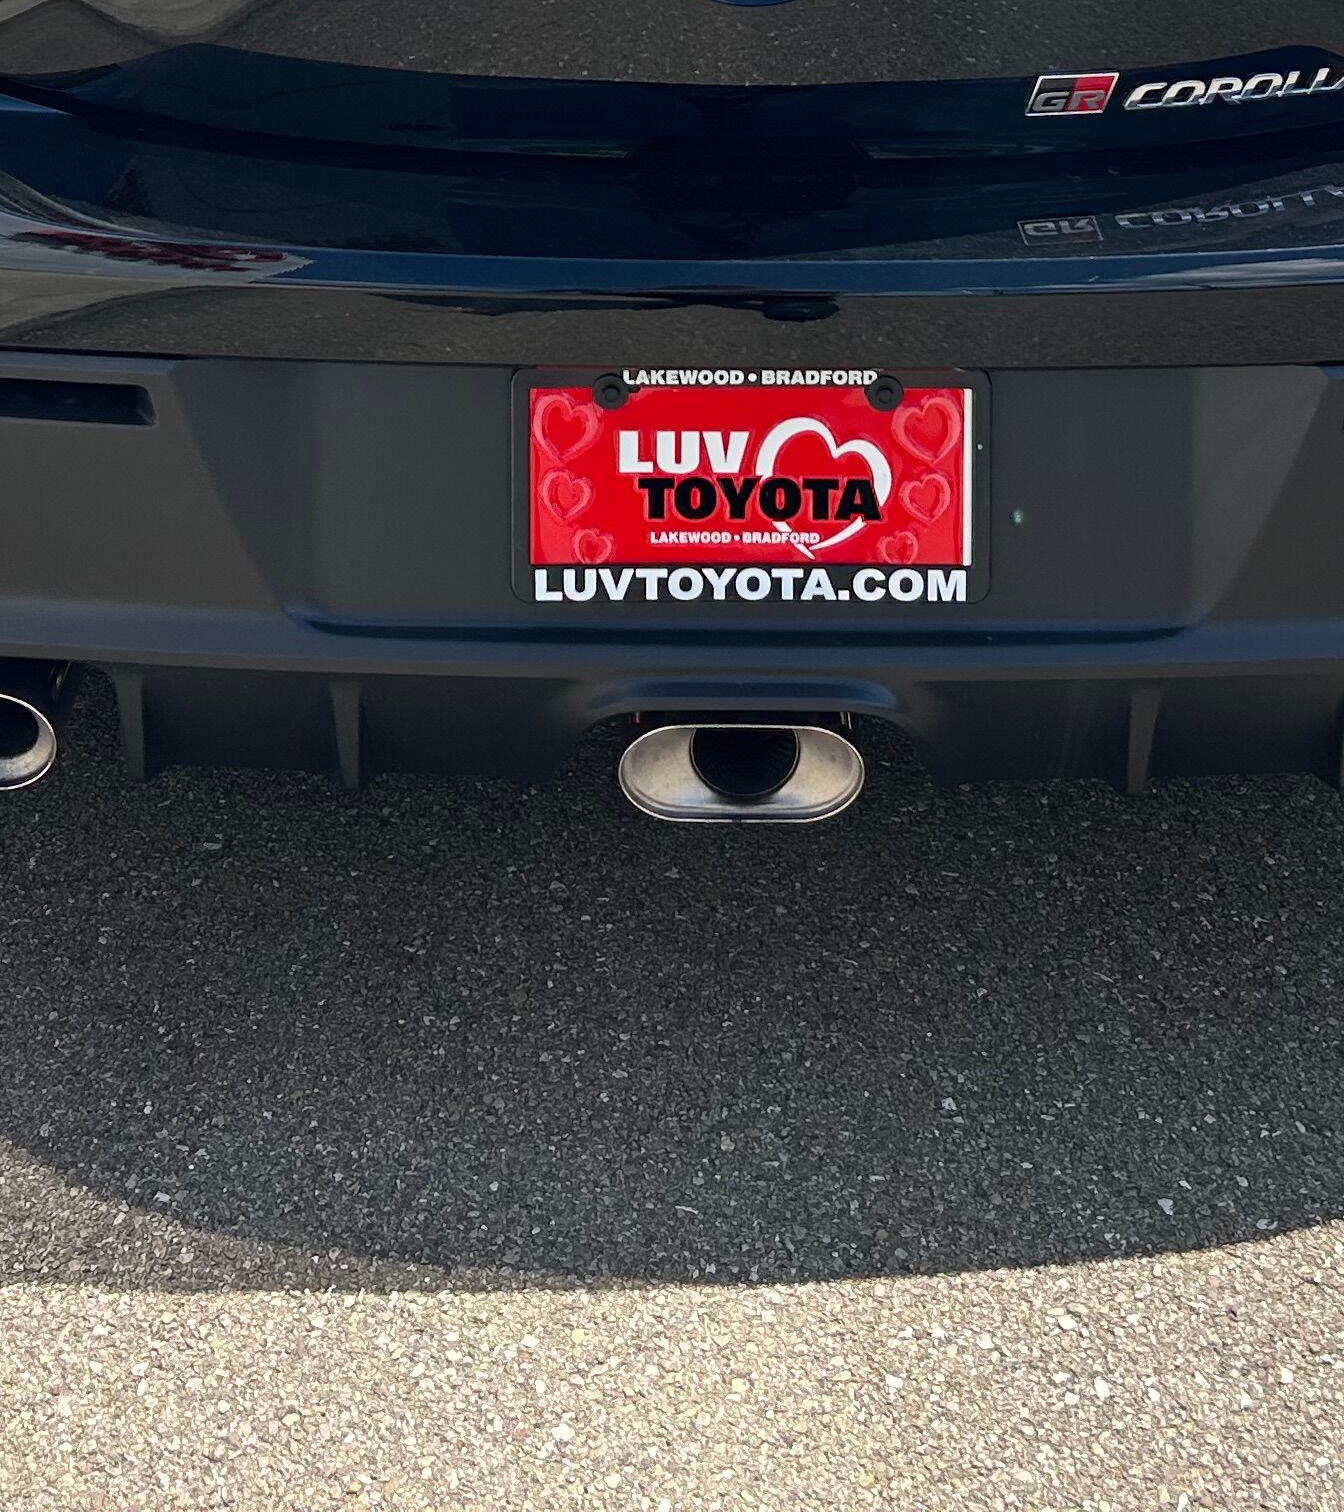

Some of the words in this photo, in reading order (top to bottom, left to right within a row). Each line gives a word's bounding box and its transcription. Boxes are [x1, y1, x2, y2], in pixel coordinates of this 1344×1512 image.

[1032, 90, 1106, 112] GR
[622, 369, 745, 386] LAKEWOOD
[761, 369, 878, 386] BRADFORD
[617, 429, 753, 474] LUV
[637, 477, 882, 521] TOYOTA
[649, 531, 732, 544] LAKEWOOD
[742, 531, 821, 544] BRADFORD
[533, 568, 968, 603] LUVTOYOTA.COM
